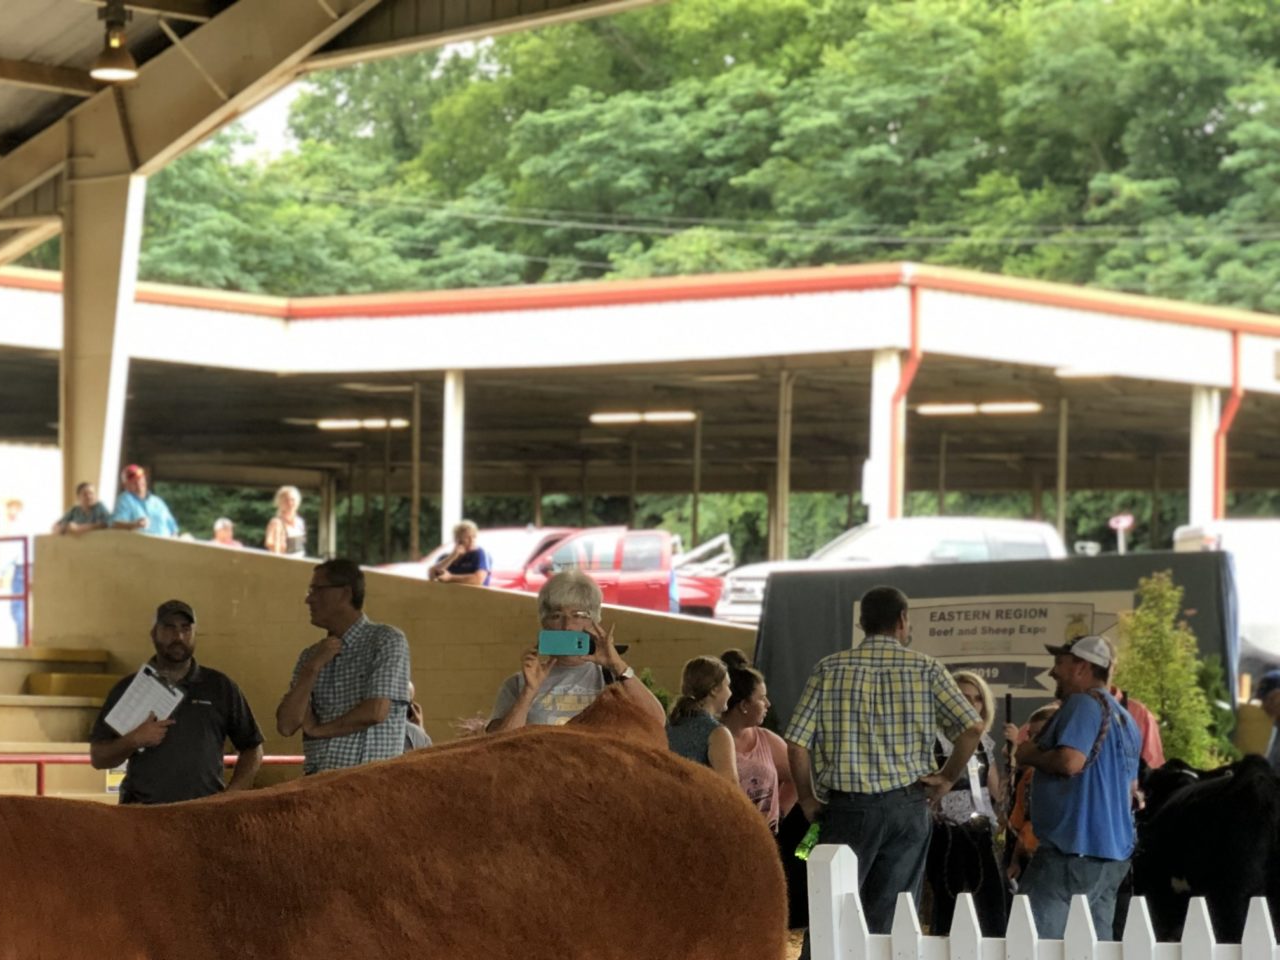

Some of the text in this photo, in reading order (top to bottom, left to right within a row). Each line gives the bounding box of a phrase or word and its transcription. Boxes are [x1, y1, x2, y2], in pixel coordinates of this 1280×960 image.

[929, 608, 1048, 622] EASTERN REGION
[928, 625, 1047, 637] Beef and Sheep Expo
